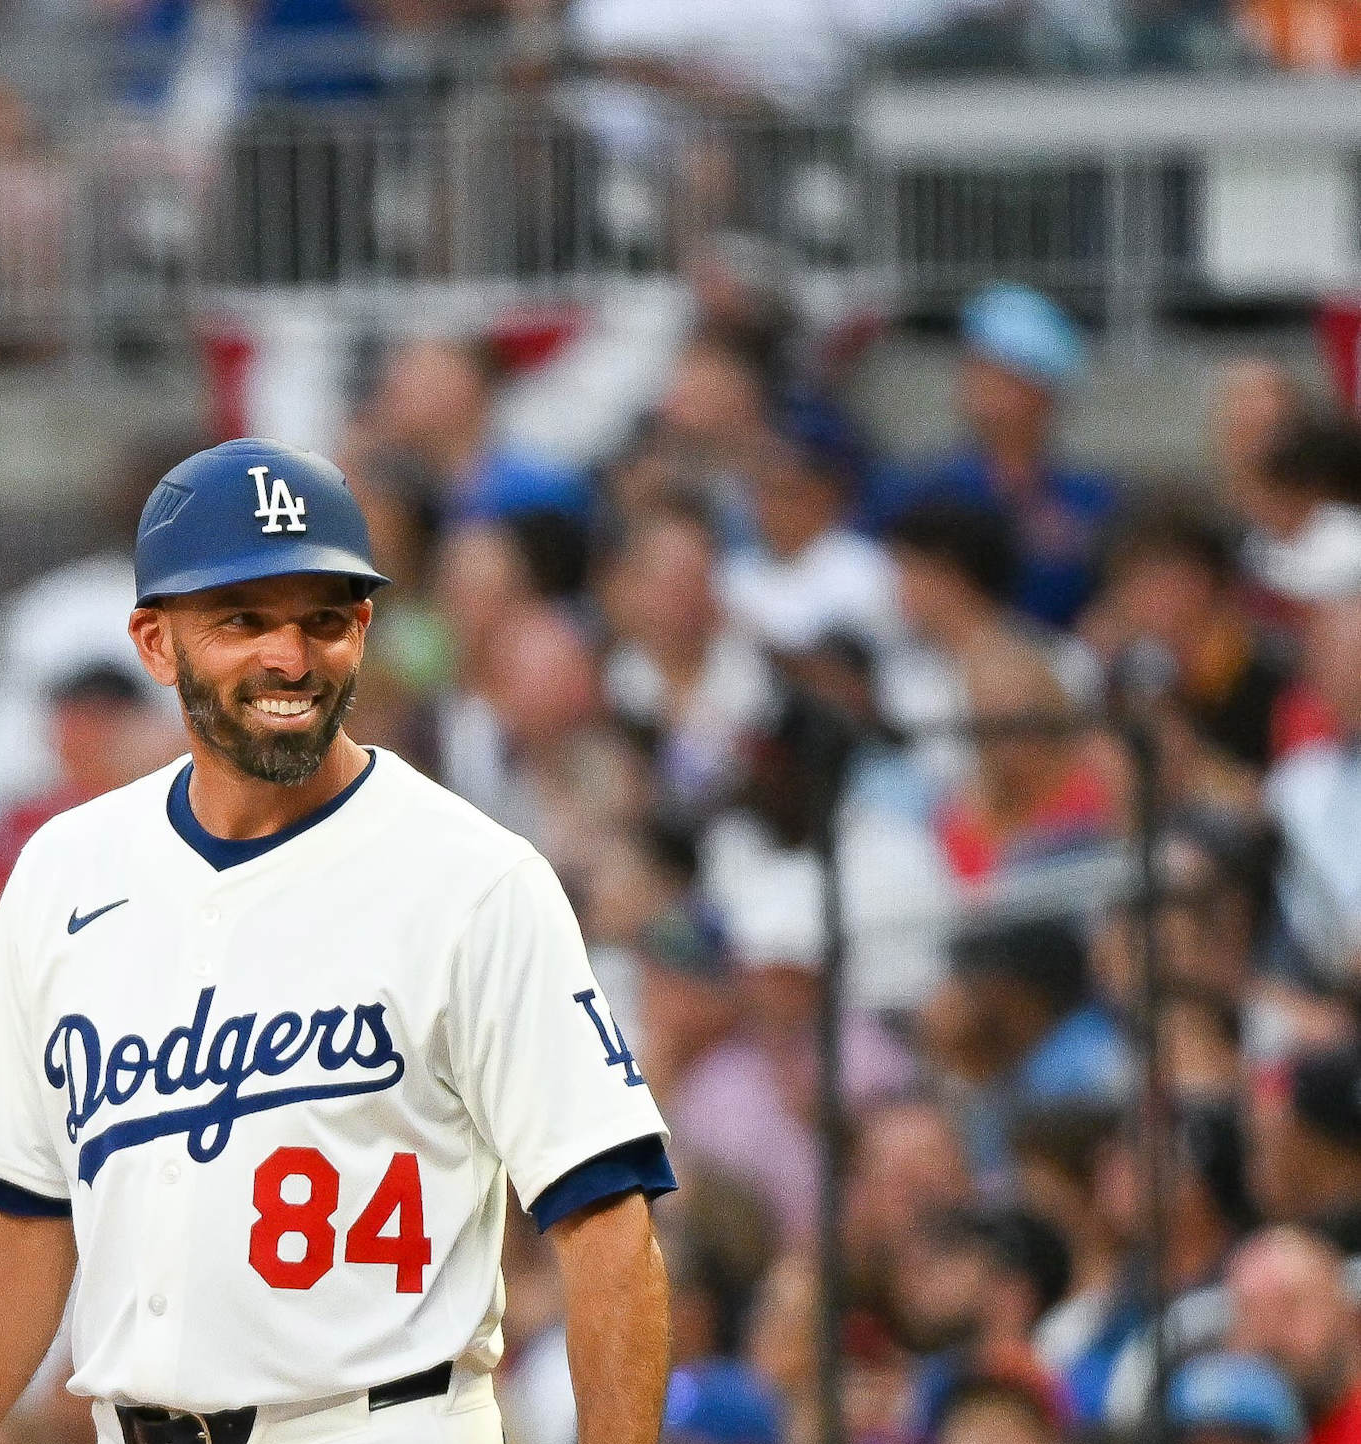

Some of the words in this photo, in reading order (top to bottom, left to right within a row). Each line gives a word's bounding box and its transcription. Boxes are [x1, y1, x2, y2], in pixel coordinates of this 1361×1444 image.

[248, 466, 307, 532] LA
[45, 985, 405, 1189] Dodgers
[248, 1146, 432, 1294] 84
